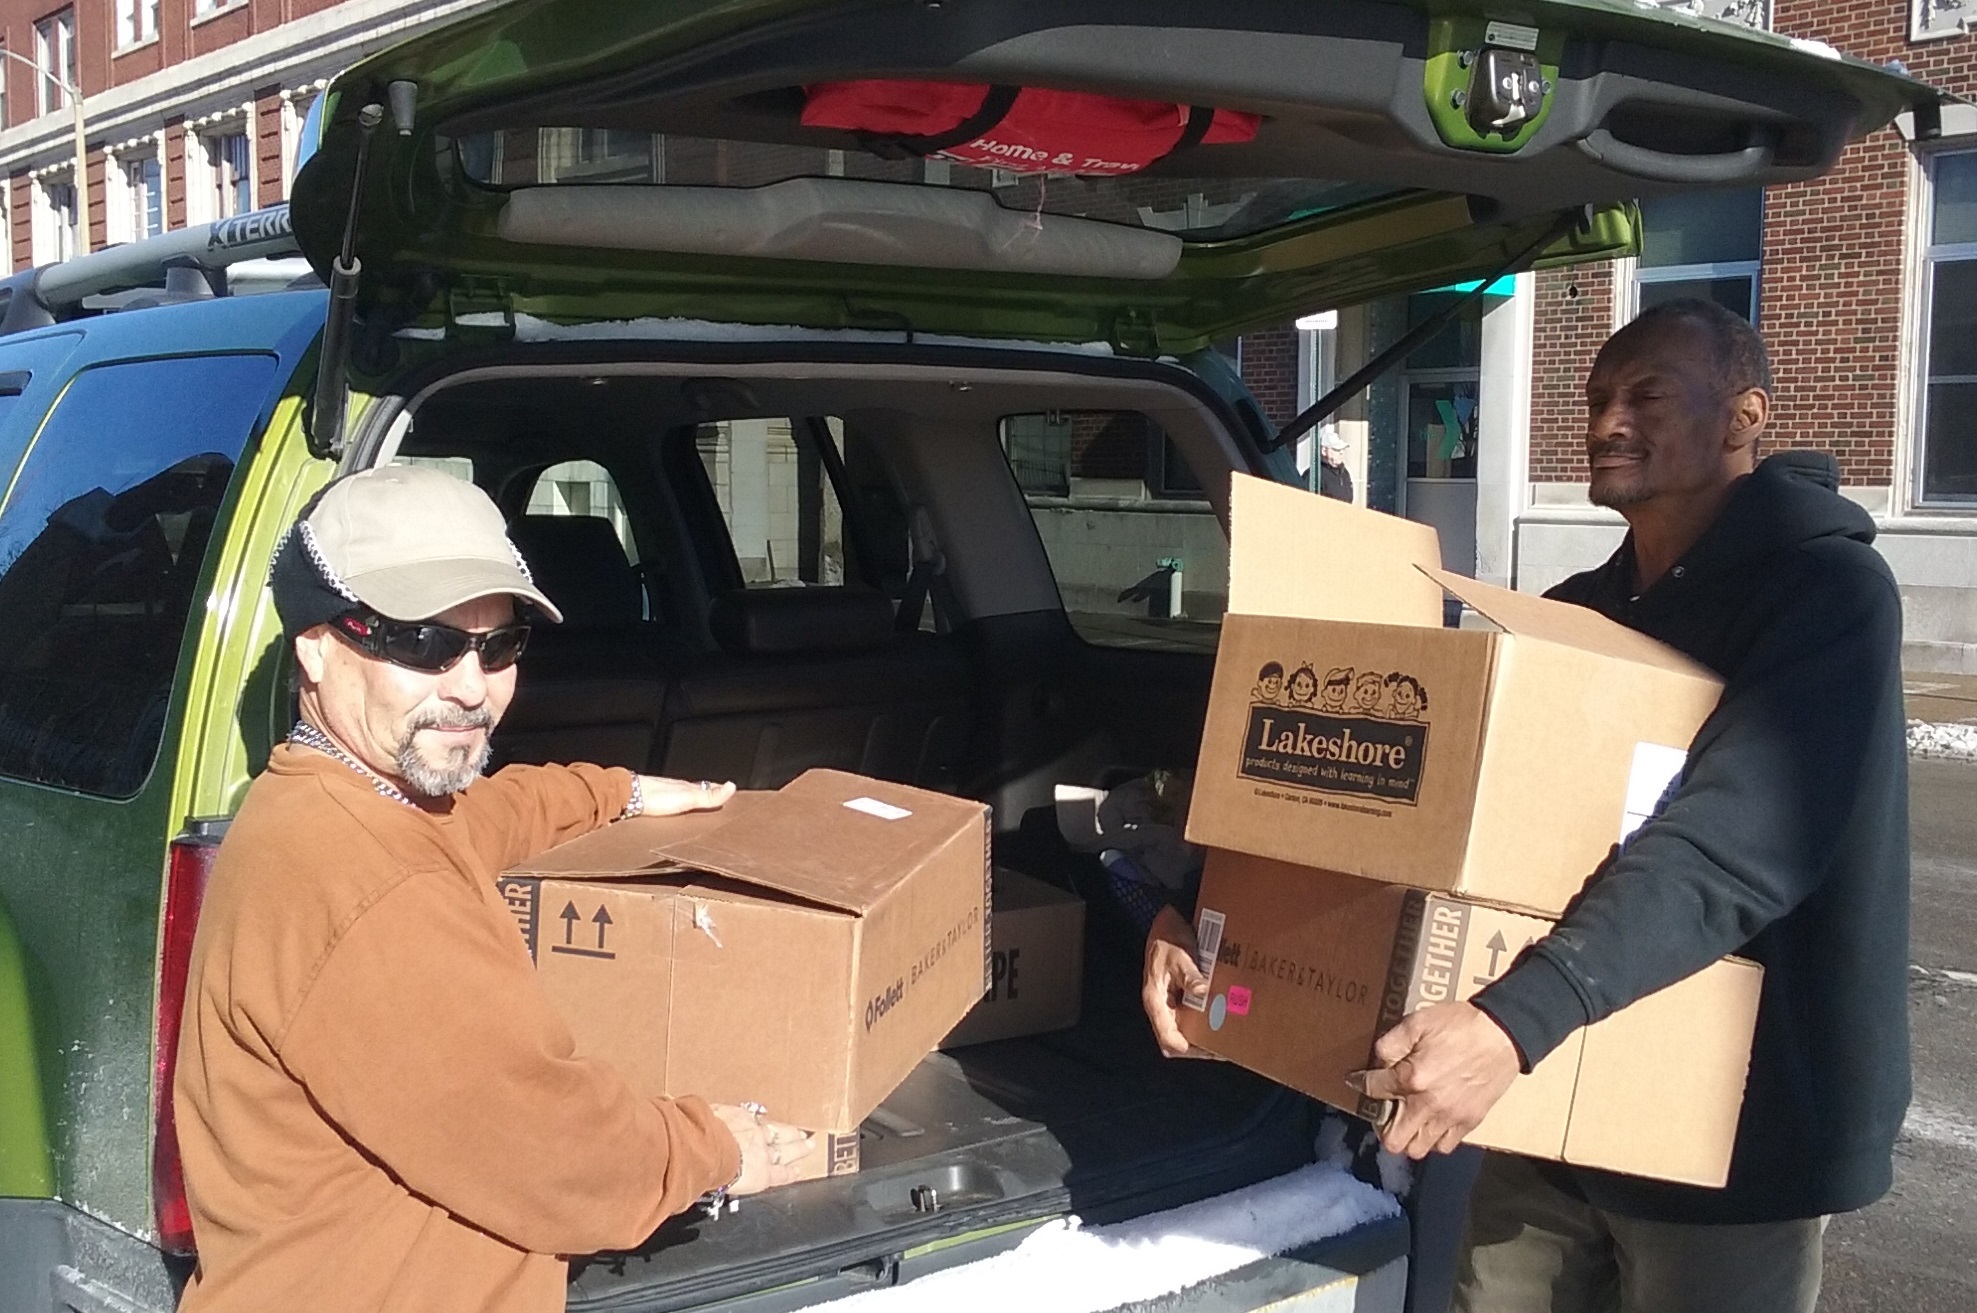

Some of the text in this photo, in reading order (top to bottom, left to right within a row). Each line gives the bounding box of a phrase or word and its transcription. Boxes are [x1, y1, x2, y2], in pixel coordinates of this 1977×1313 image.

[969, 138, 1049, 162] Home
[1051, 152, 1075, 166] &
[1080, 157, 1141, 171] Trav
[206, 208, 293, 252] XTERR
[1245, 757, 1281, 771] products
[1282, 760, 1319, 778] designed
[1320, 765, 1339, 780] with
[1340, 768, 1375, 789] learning
[1376, 773, 1386, 786] in
[874, 906, 979, 1024] Follett BAKER&TAYLOR
[983, 947, 1020, 1004] PE
[1250, 950, 1369, 1006] BAKER&TAYLOR
[1382, 898, 1422, 1023] TOGETHER
[1415, 906, 1463, 1011] GETHER
